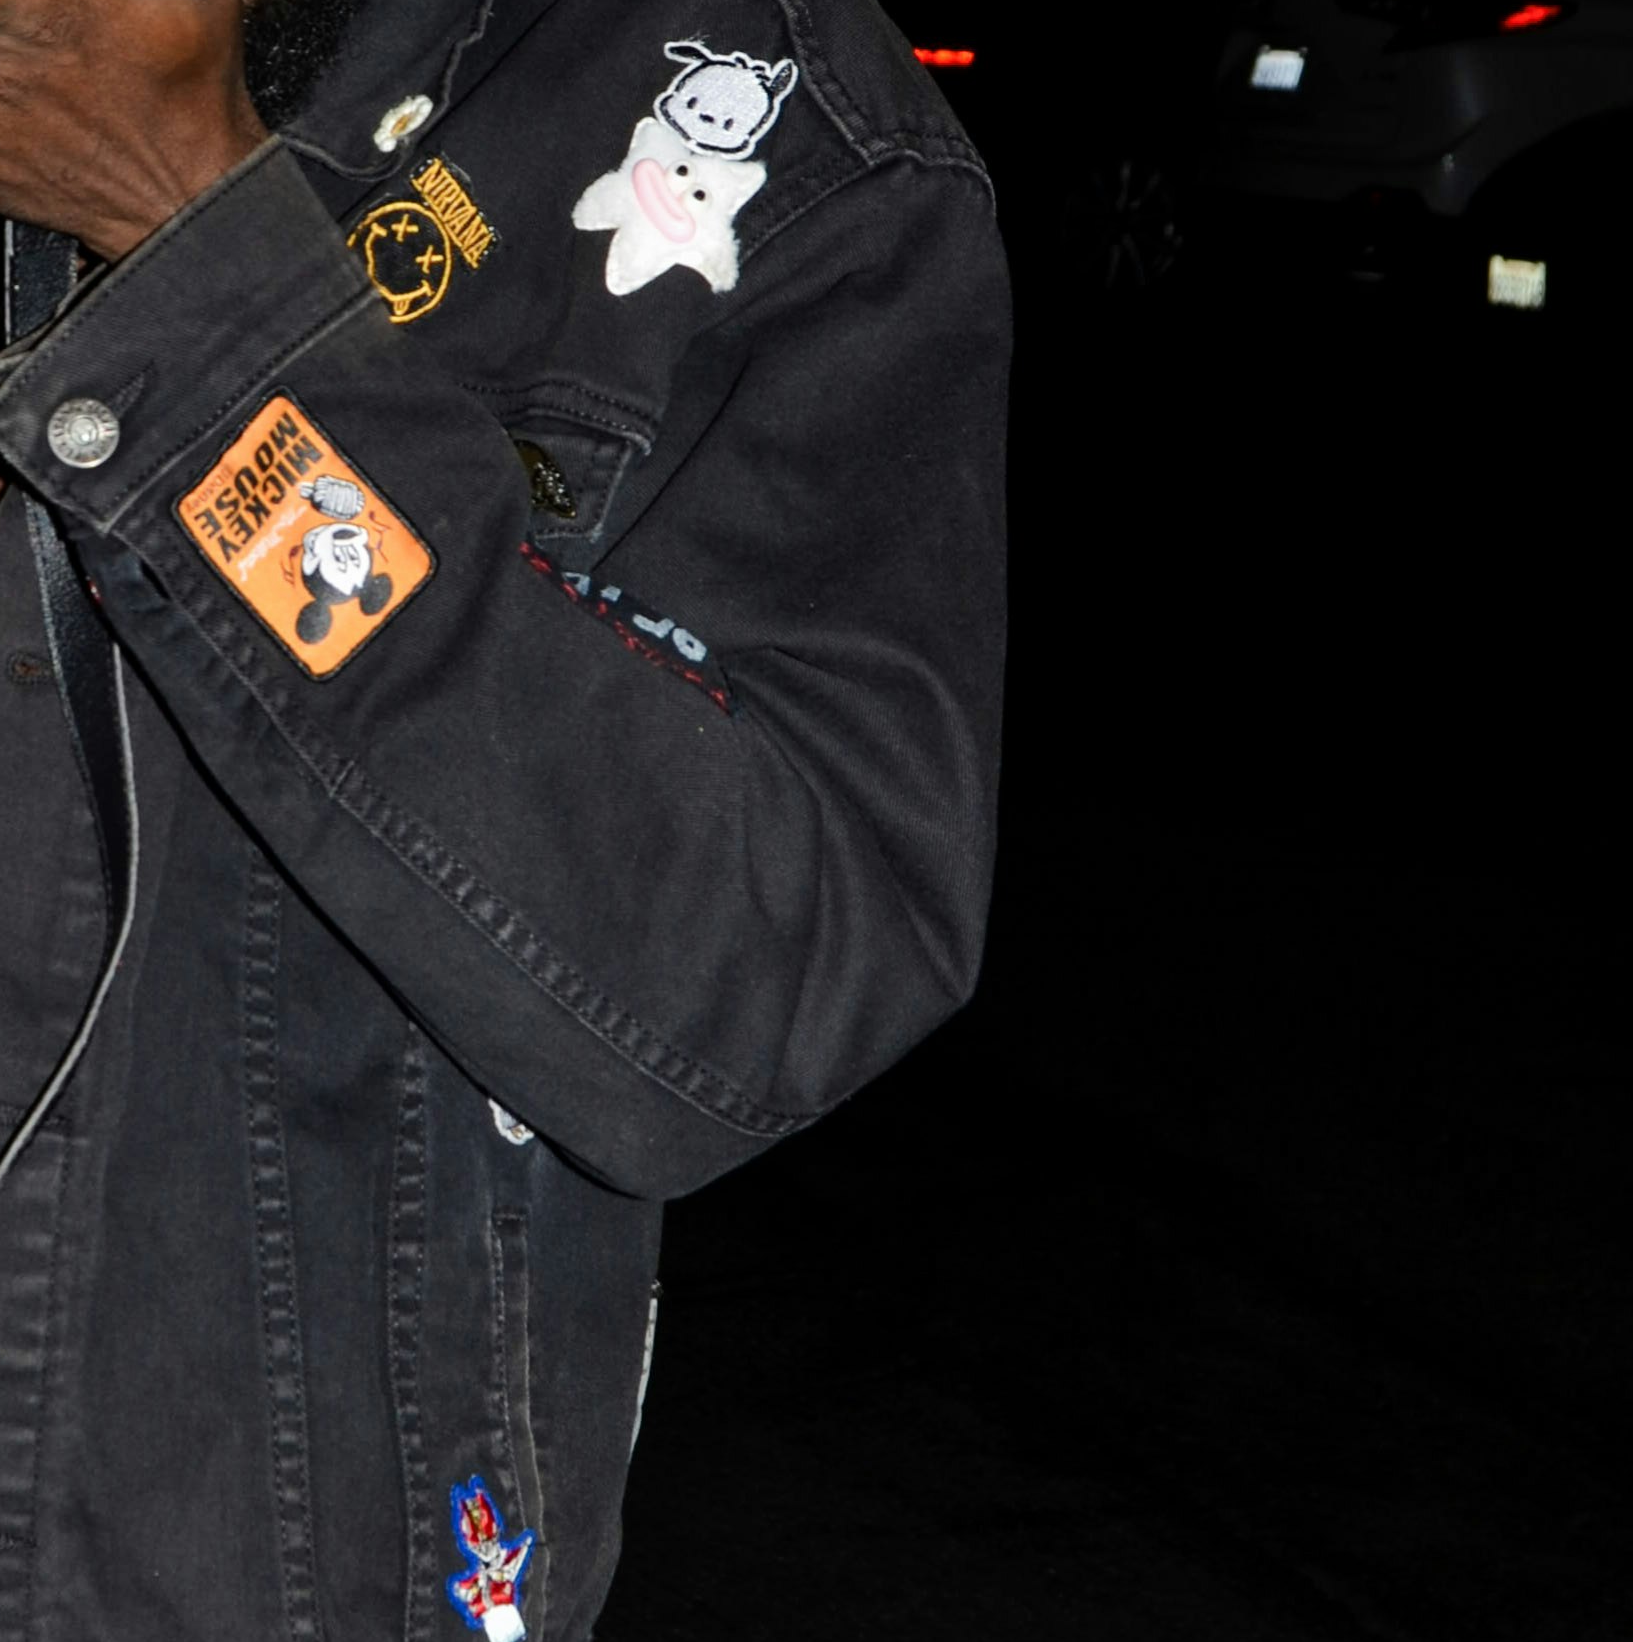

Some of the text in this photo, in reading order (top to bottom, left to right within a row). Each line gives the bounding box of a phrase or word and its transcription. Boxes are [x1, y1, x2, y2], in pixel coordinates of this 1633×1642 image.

[411, 158, 495, 269] NIRVANA
[194, 411, 300, 539] MOUSE
[218, 436, 323, 563] MICKEY
